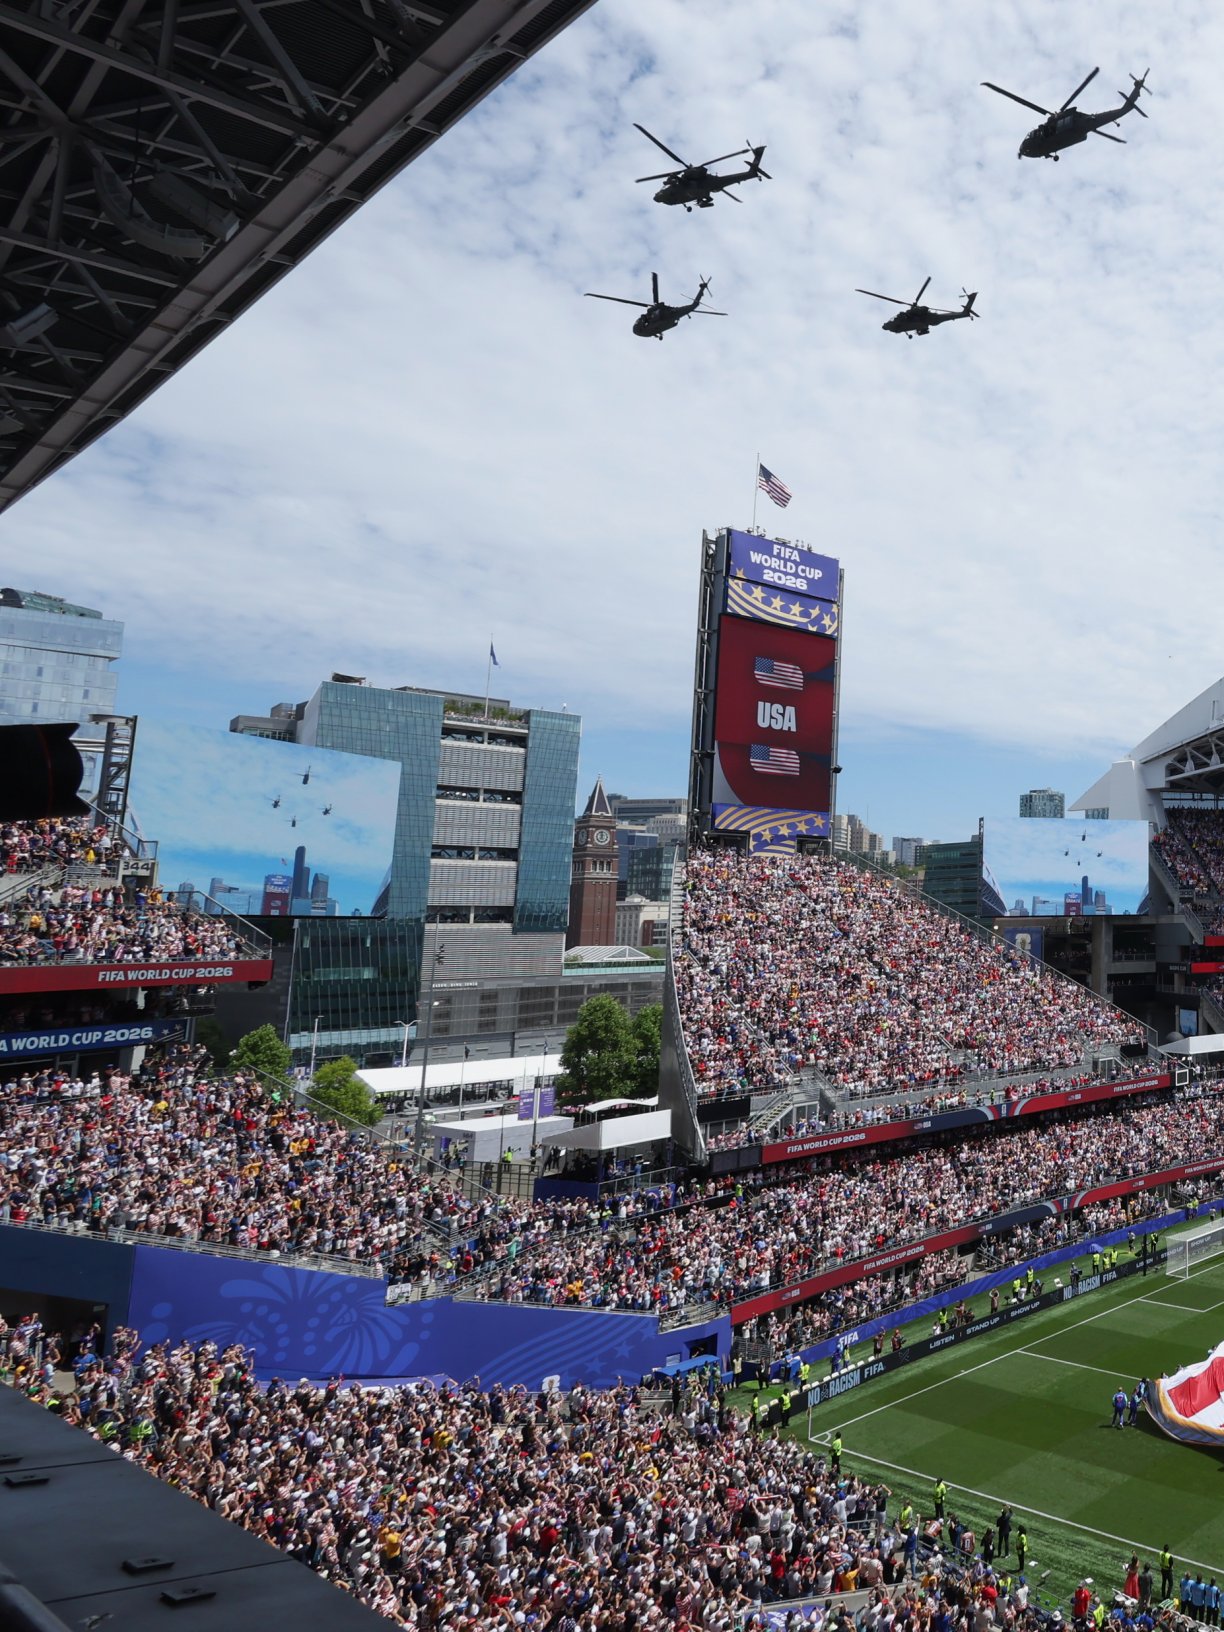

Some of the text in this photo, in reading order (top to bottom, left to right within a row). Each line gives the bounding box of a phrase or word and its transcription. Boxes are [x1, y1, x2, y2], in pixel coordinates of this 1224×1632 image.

[773, 544, 800, 562] FIFA
[750, 551, 823, 580] WORLD CUP
[763, 569, 808, 590] 2026
[757, 701, 797, 732] USA
[122, 861, 151, 872] 344
[98, 967, 234, 982] FIFA WORLD CUP 2026
[12, 1034, 70, 1051] WORLD
[71, 1031, 103, 1046] CUP
[103, 1027, 154, 1043] 2026
[787, 1133, 867, 1154] FIFA WORLD CUP 2026
[862, 1245, 925, 1271] FIFA WORLD CUP 2026
[1063, 1271, 1117, 1301] NO RACISM FIFA
[1010, 1301, 1041, 1318] SHOW UP
[966, 1316, 1000, 1335] STAND UP
[929, 1334, 955, 1349] LISTEN
[807, 1361, 885, 1408] NO RACISM FIFA
